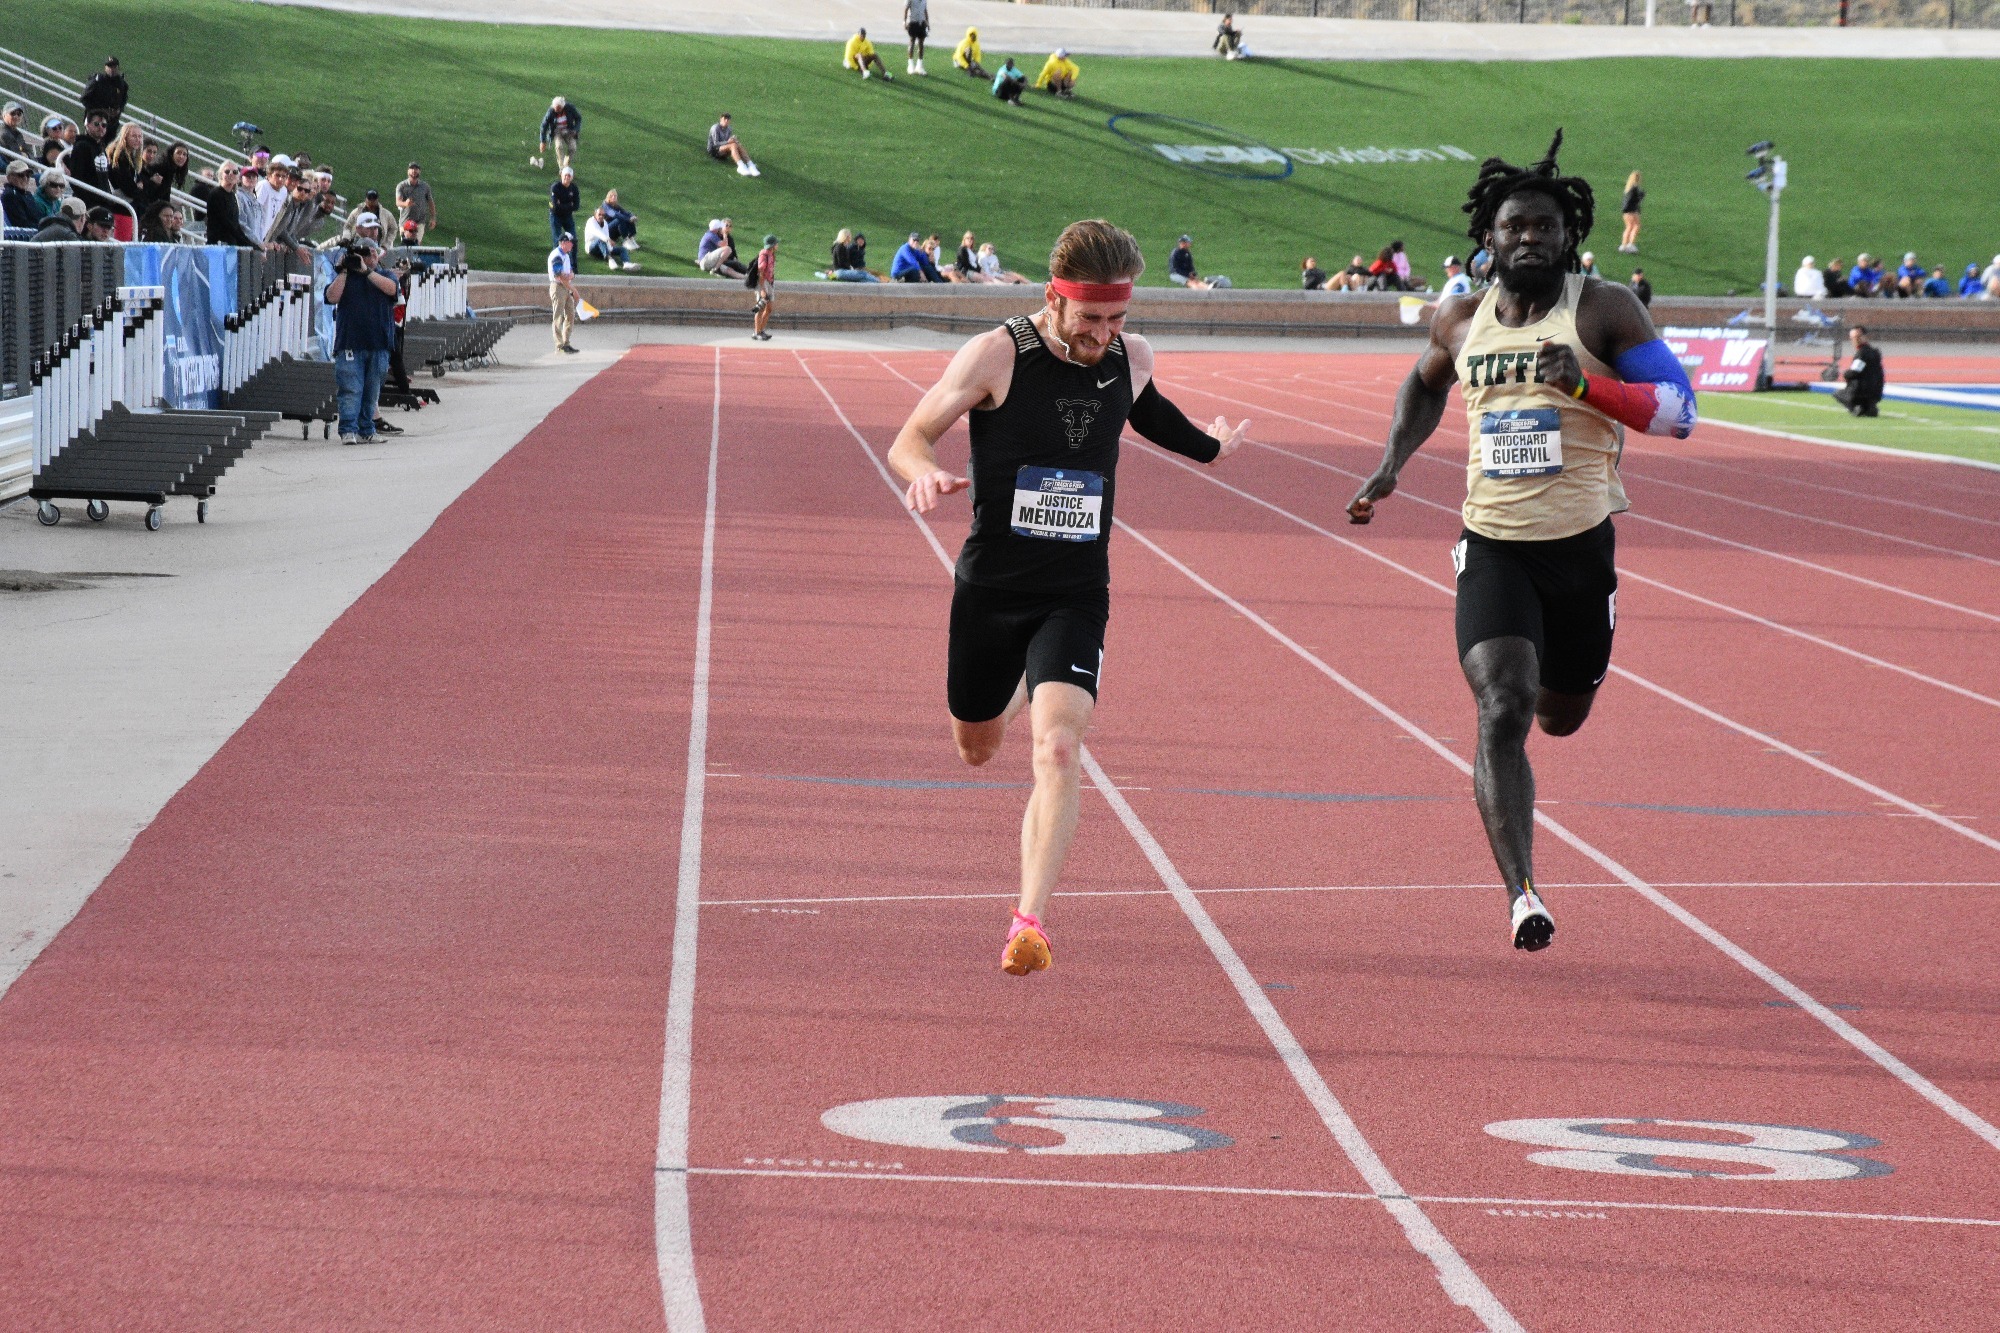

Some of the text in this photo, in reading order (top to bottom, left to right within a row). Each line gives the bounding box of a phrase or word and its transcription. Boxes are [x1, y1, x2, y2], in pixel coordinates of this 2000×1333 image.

[1720, 340, 1768, 367] WT
[1492, 433, 1548, 447] WIDCHARD
[1492, 447, 1551, 465] GUERVIL
[1037, 494, 1084, 510] JUSTICE
[1018, 506, 1095, 529] MENDOZA
[1482, 1117, 1897, 1182] 8
